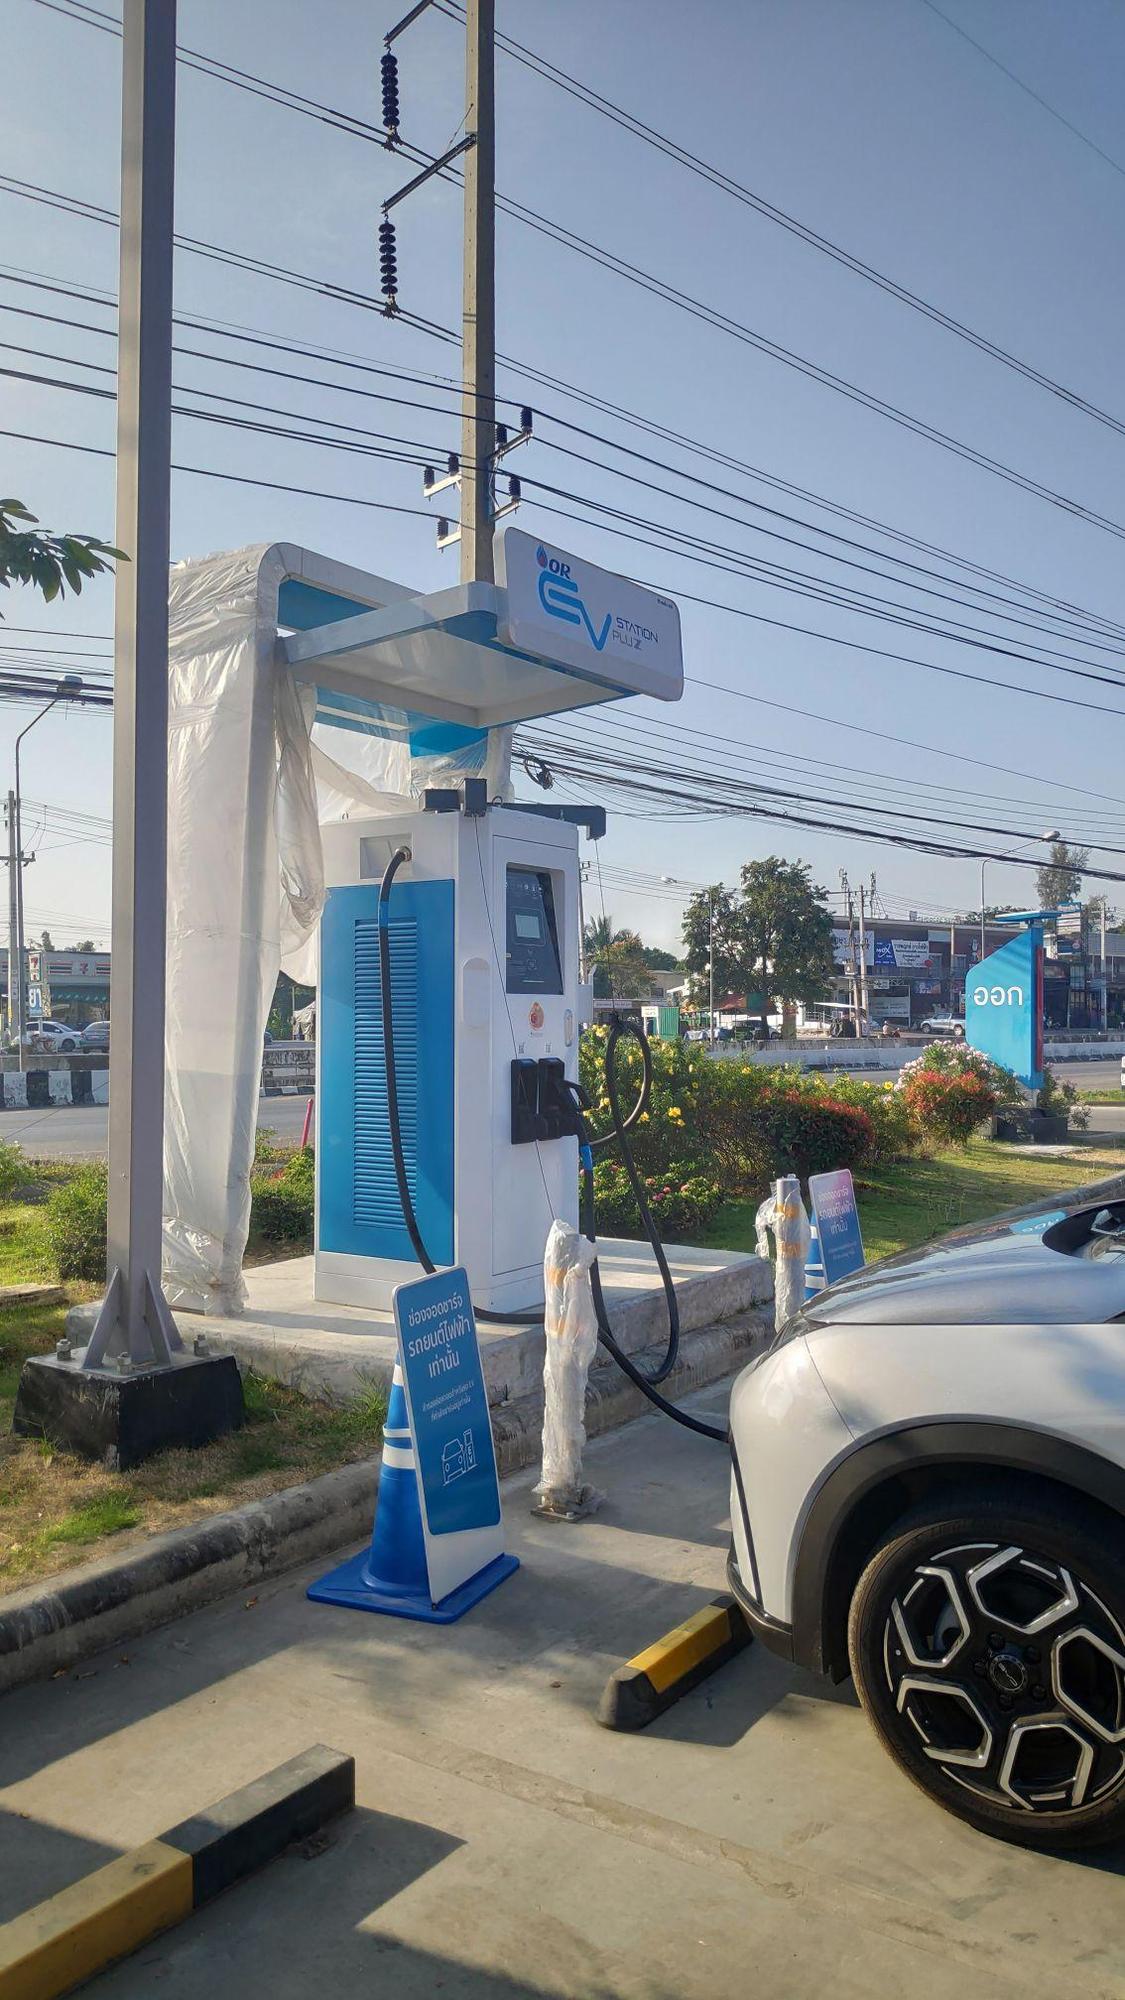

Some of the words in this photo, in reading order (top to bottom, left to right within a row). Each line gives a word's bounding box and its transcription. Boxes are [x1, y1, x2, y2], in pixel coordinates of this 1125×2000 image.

[548, 558, 571, 579] OR
[538, 570, 612, 651] EV
[616, 617, 659, 643] STATION
[612, 630, 642, 650] PLUZ
[973, 986, 1023, 1006] ออก
[408, 1291, 463, 1327] ช่องจอดชาร์จ
[408, 1313, 471, 1357] รถยนต์ไฟฟ้า
[428, 1343, 460, 1378] เท่านั้น
